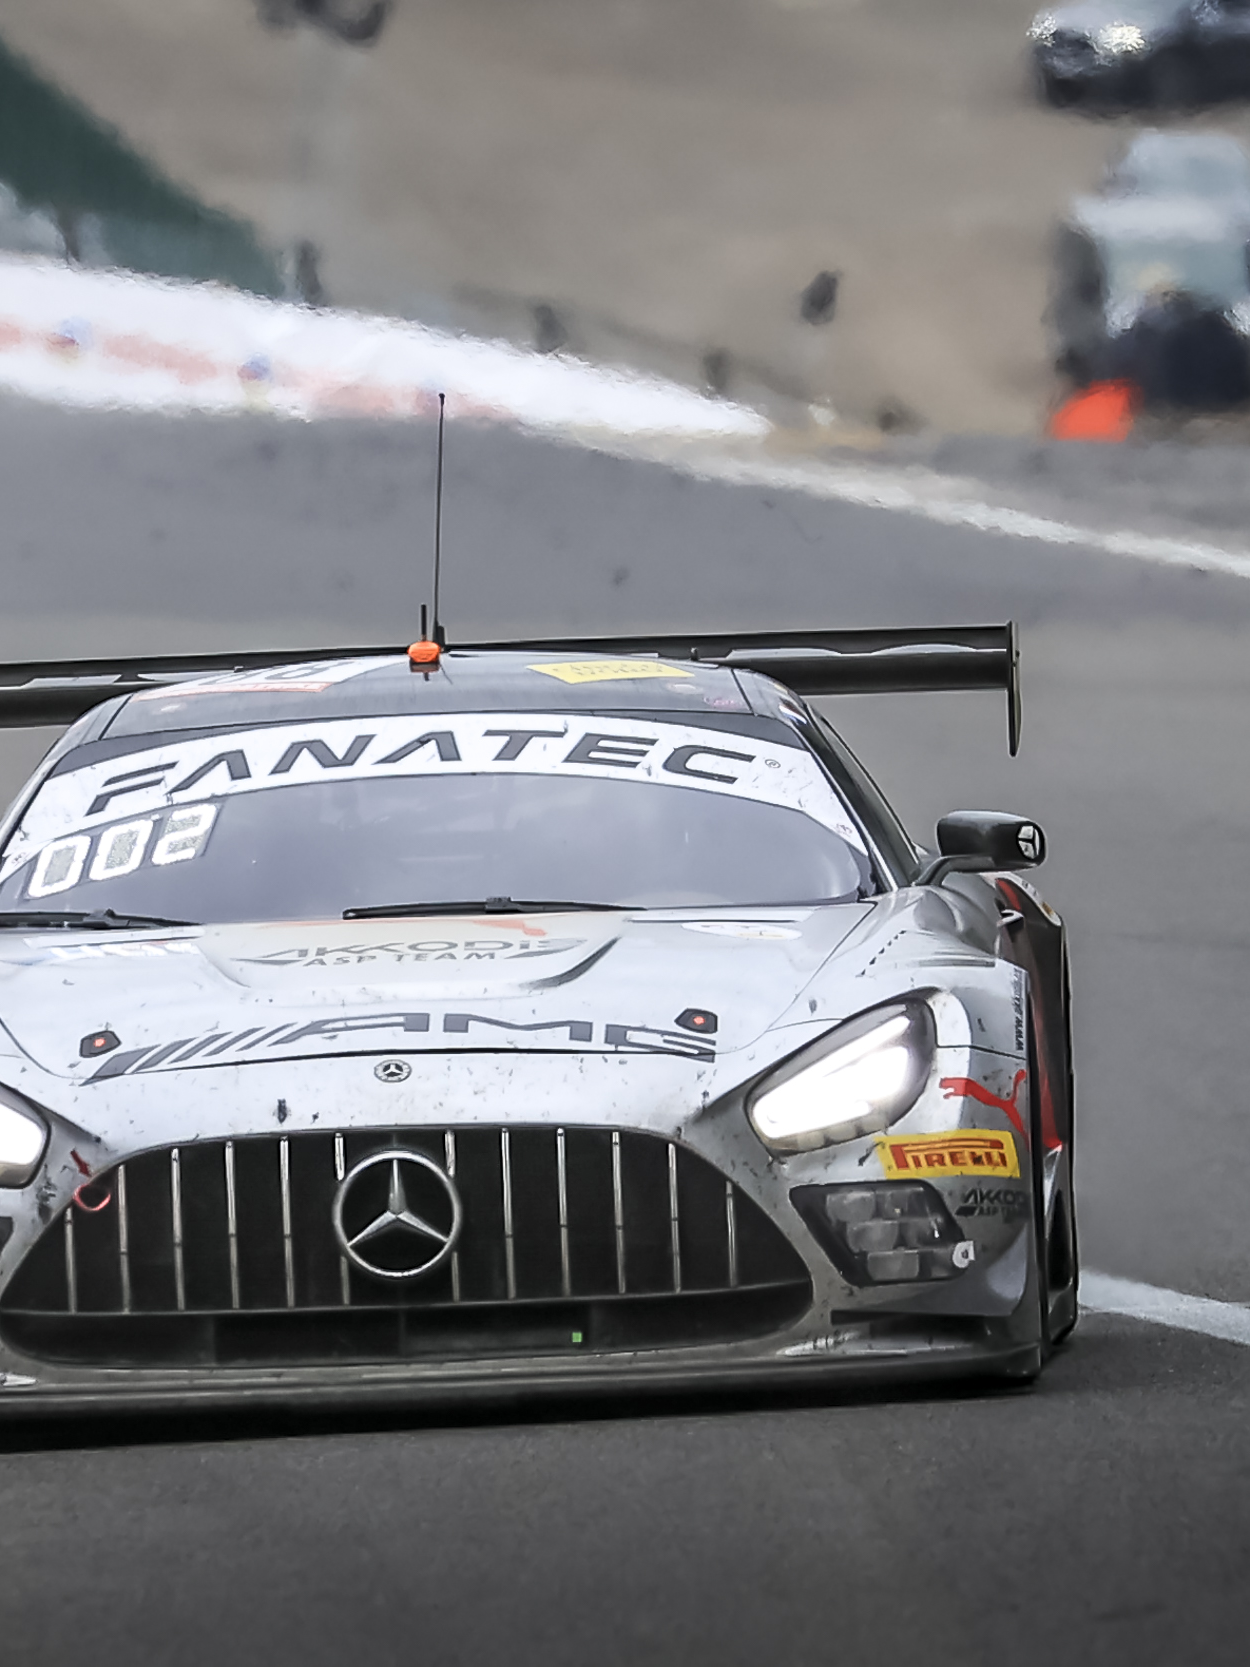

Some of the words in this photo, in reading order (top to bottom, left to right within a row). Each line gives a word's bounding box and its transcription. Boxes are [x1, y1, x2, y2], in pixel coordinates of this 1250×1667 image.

[84, 728, 757, 817] FANATEC
[27, 803, 221, 900] 002
[302, 954, 378, 968] ASP
[394, 952, 496, 962] TEAM
[268, 1011, 716, 1063] AMG
[889, 1137, 1007, 1170] PIRELLI
